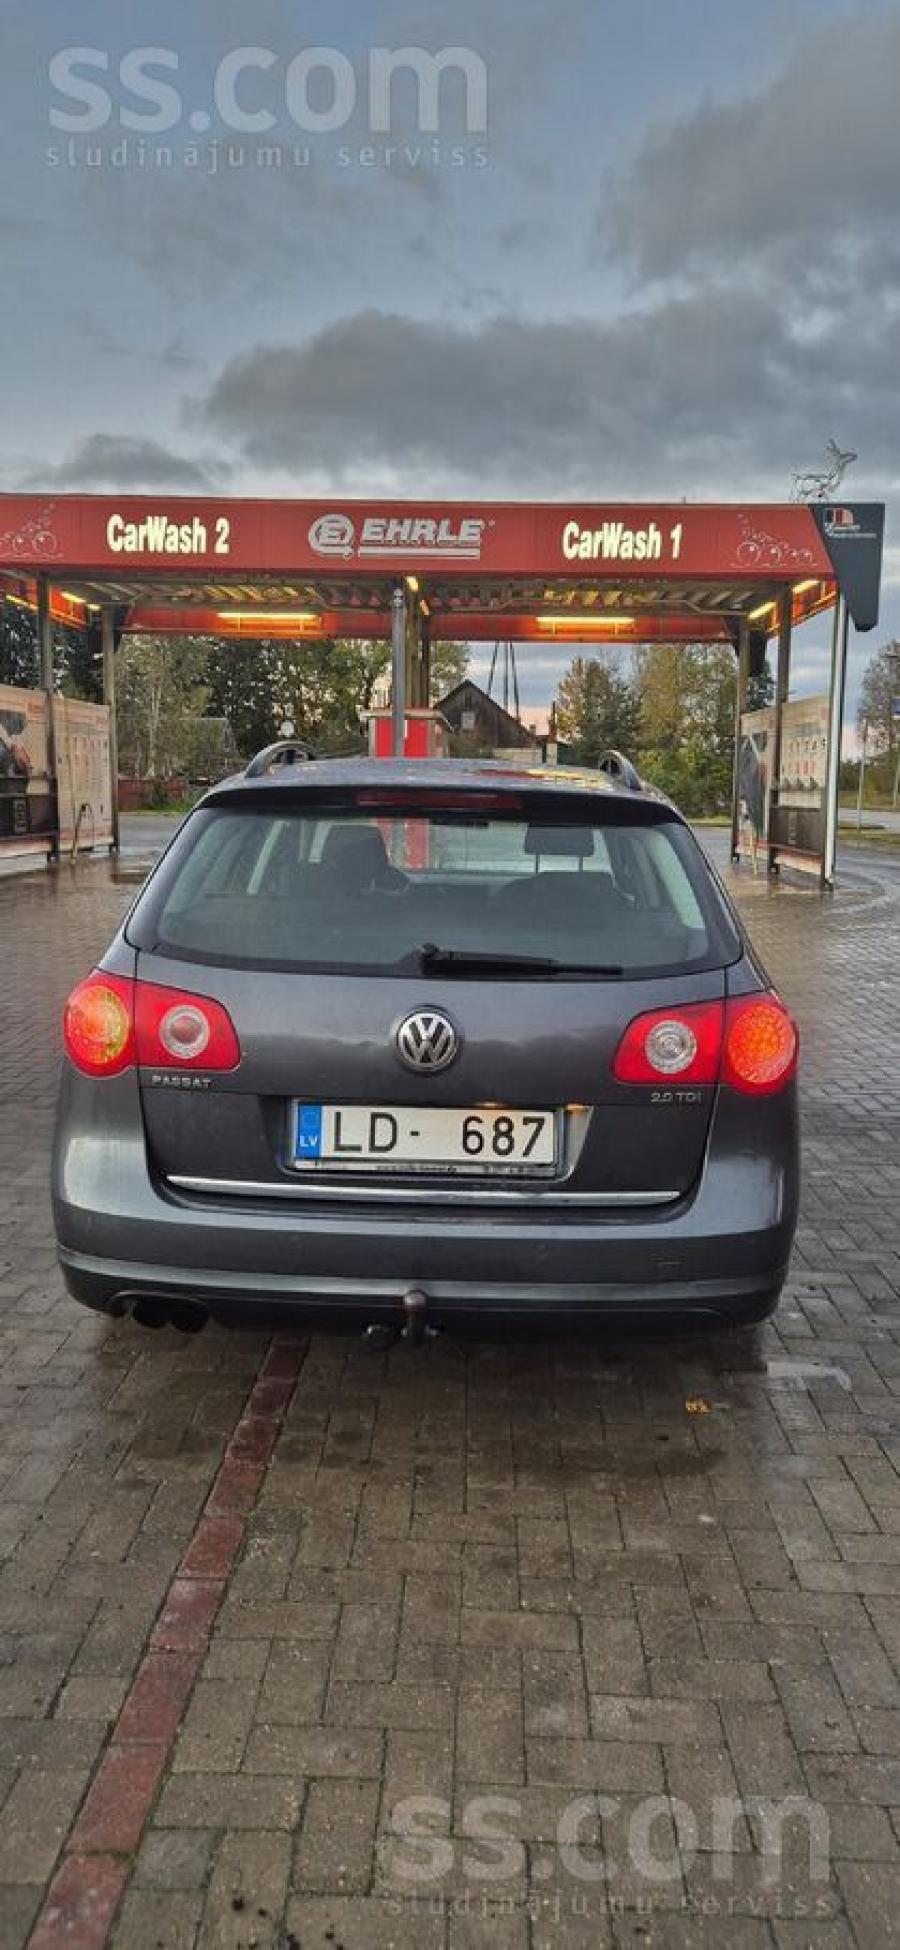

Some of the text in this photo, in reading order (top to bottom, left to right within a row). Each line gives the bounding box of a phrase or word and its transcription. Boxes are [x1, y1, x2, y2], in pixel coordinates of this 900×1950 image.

[106, 514, 230, 554] CarWash 2
[360, 518, 482, 543] EHRLE
[562, 521, 683, 560] CarWash 1
[151, 1075, 213, 1089] PASSAT
[675, 1092, 703, 1104] TDI
[300, 1135, 318, 1148] LV
[462, 1115, 545, 1157] 687
